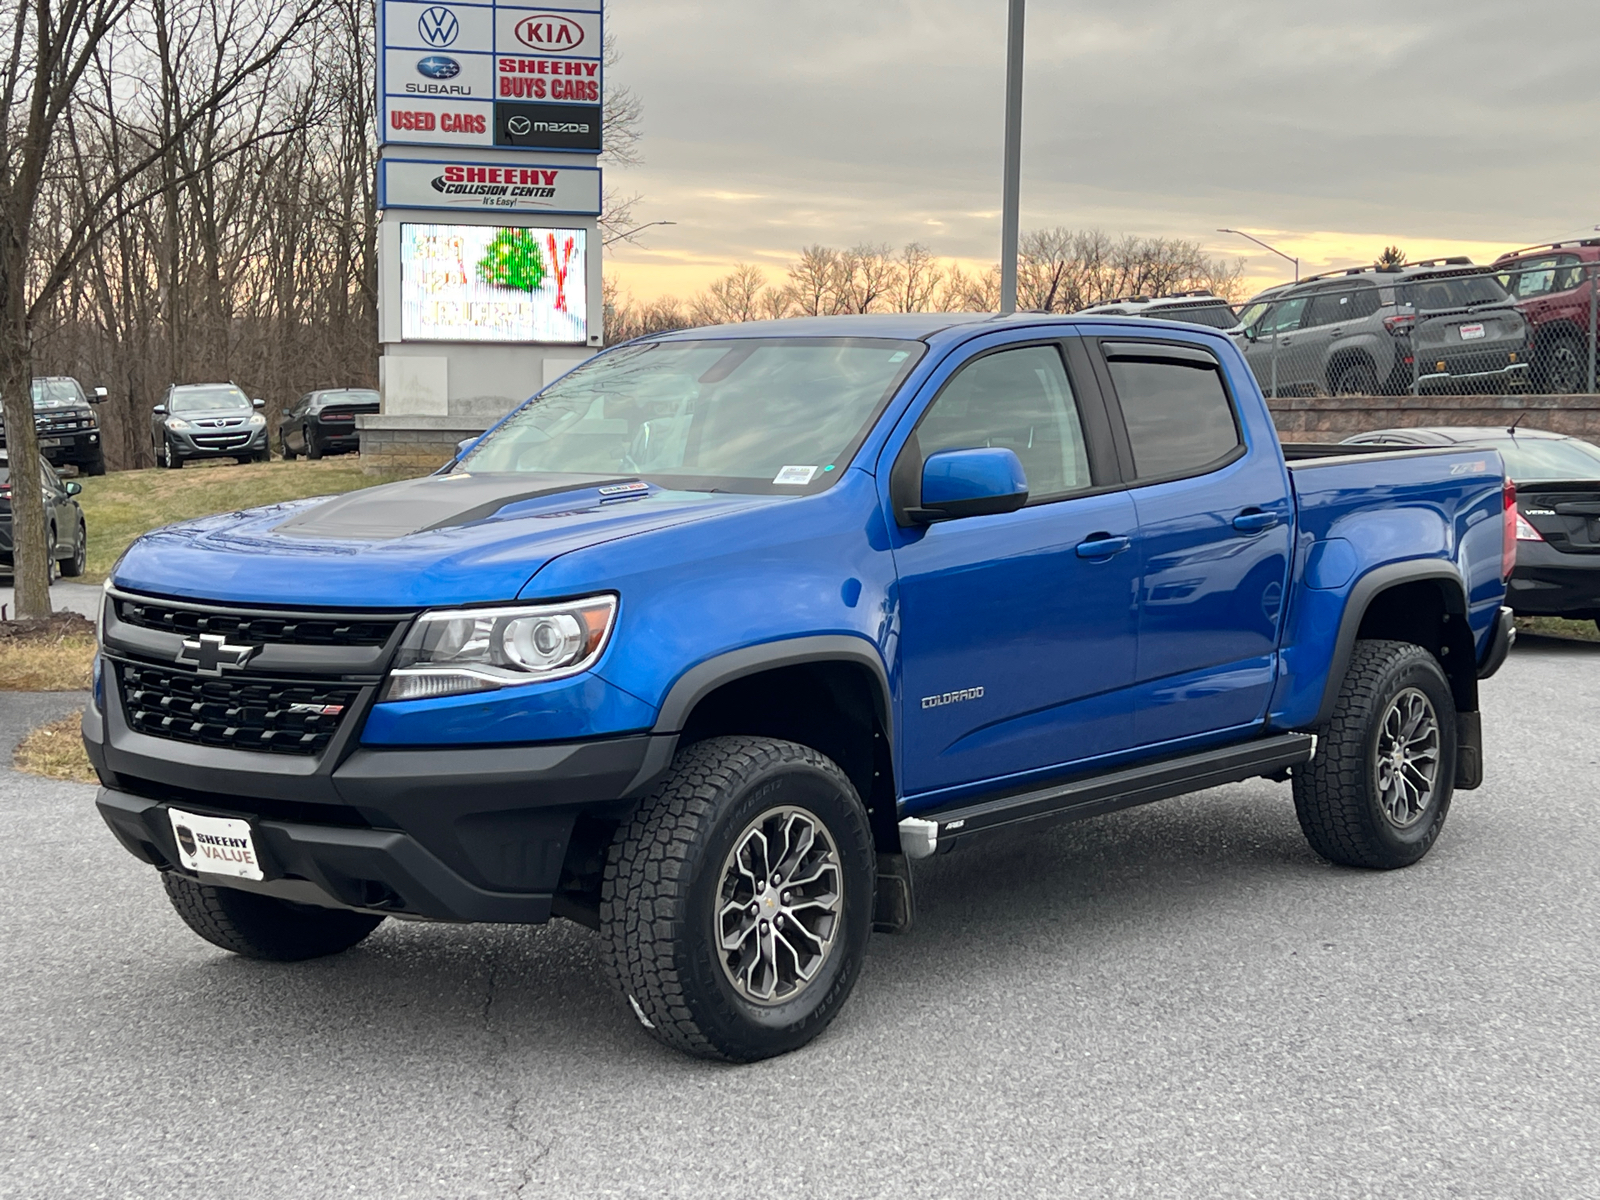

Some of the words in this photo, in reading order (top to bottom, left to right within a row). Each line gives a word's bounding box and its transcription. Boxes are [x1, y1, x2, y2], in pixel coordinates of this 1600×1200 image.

[527, 22, 573, 44] KIA
[499, 58, 598, 76] SHEEHY
[405, 83, 472, 96] SUBARU
[500, 76, 546, 99] BUYS
[551, 78, 599, 101] CARS
[391, 110, 436, 132] USED
[440, 112, 486, 134] CARS
[445, 166, 558, 185] SHEEHY
[445, 183, 509, 196] COLLISION
[510, 186, 556, 198] CENTER
[482, 196, 494, 206] It's
[495, 197, 518, 208] Easy!
[921, 686, 984, 709] COLORADO
[196, 832, 248, 849] SHEEHY
[200, 844, 254, 865] VALUE
